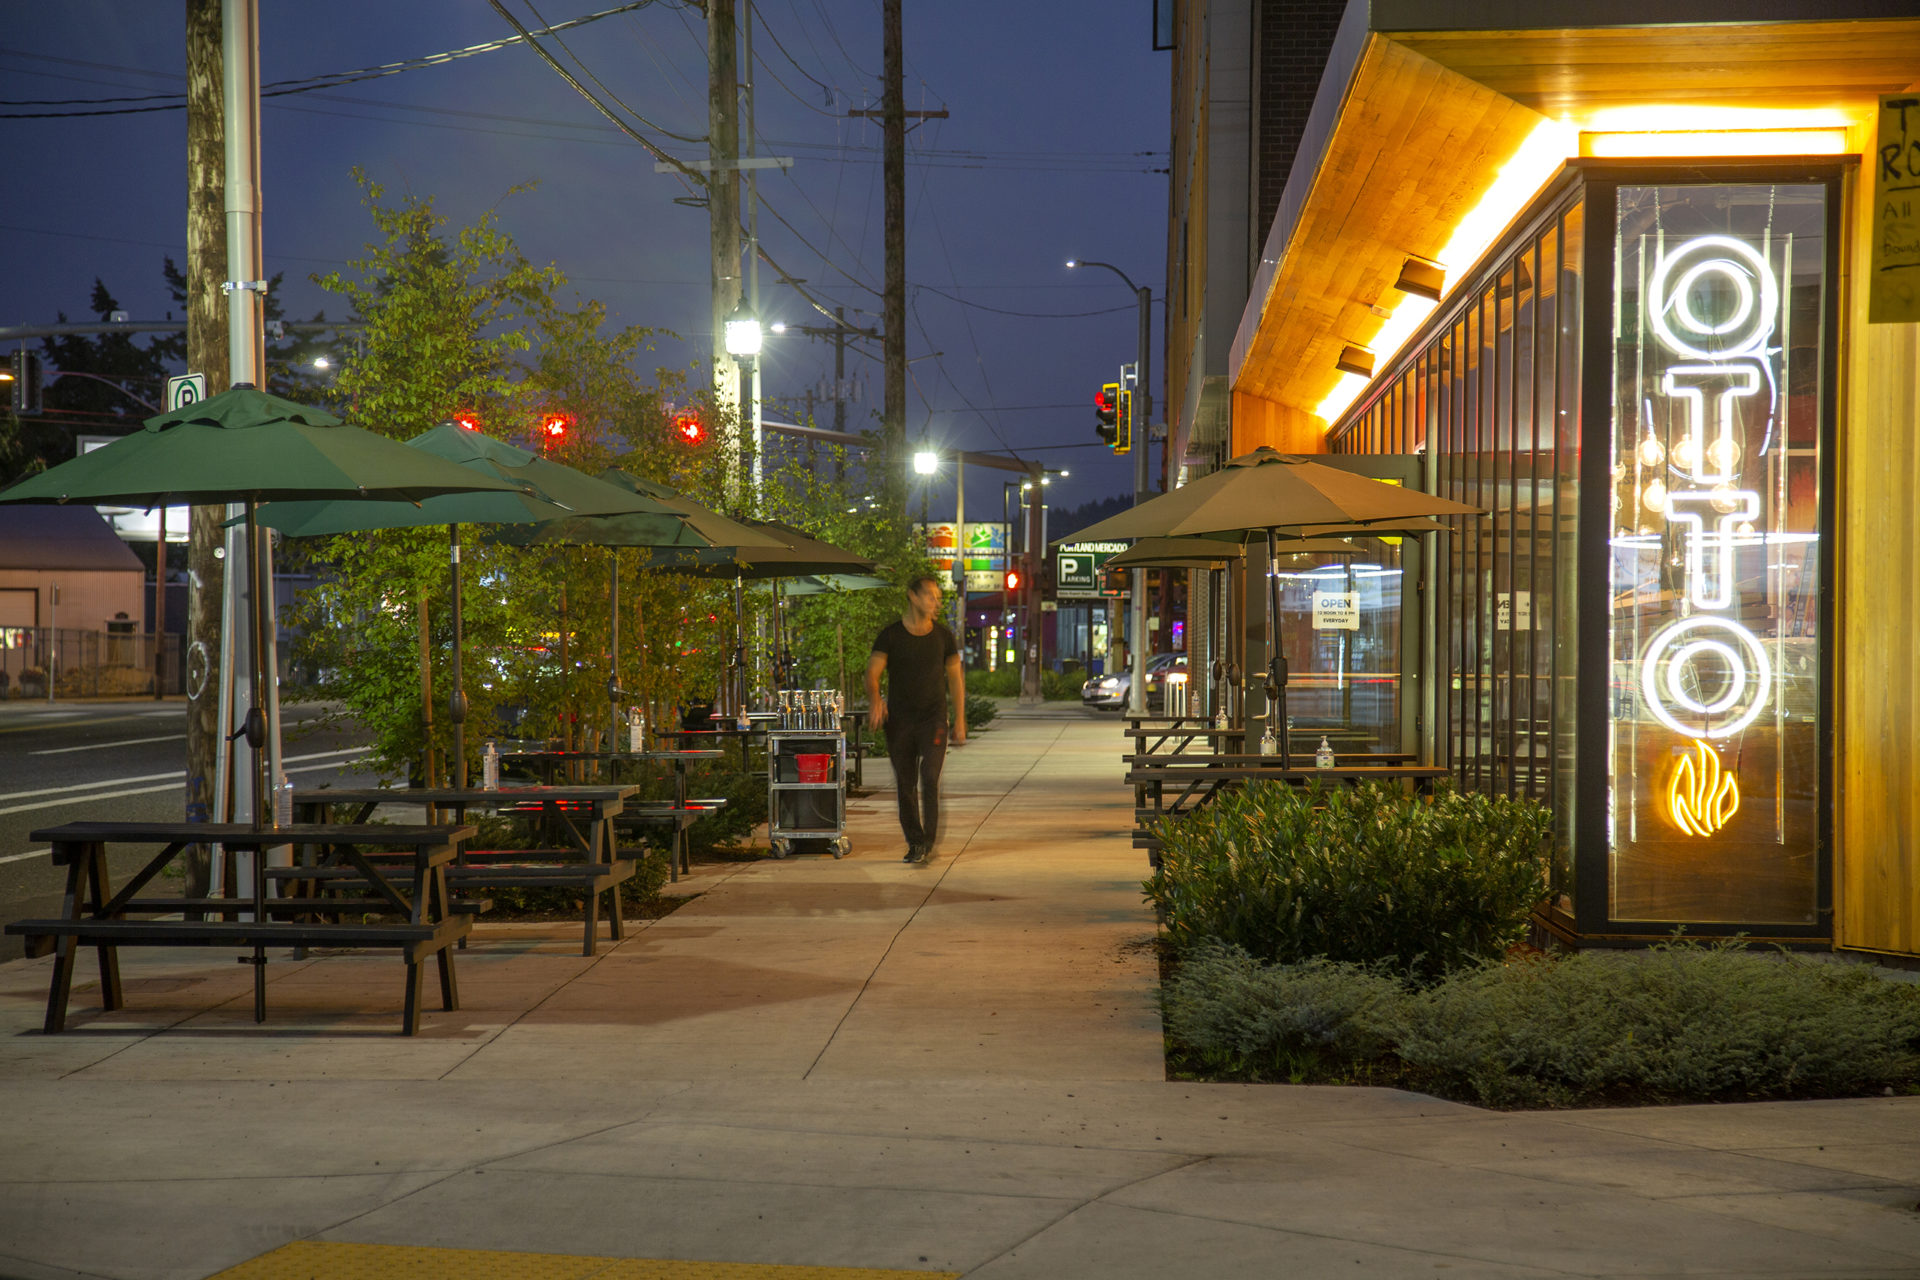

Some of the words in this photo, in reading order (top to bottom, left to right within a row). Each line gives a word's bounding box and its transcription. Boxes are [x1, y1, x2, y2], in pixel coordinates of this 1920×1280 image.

[1642, 235, 1779, 739] OTTO
[1095, 543, 1128, 553] MERCADO
[1321, 599, 1351, 608] OPEN
